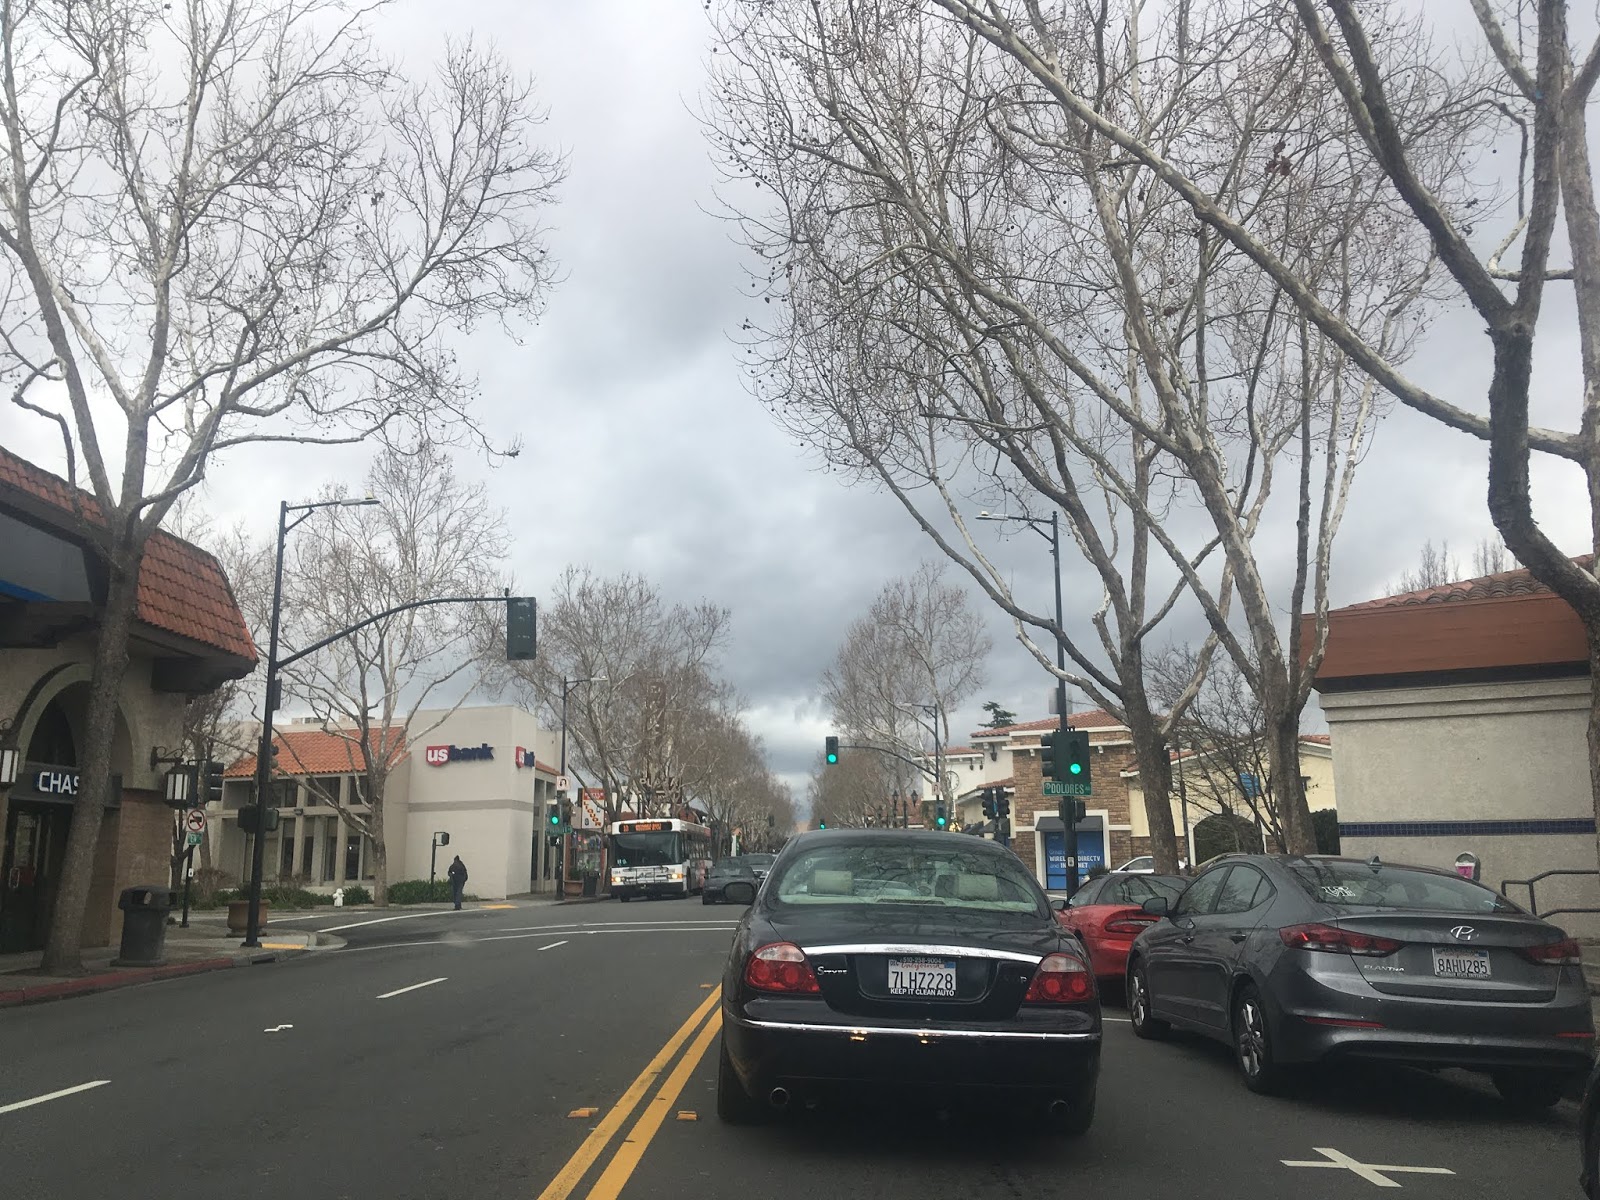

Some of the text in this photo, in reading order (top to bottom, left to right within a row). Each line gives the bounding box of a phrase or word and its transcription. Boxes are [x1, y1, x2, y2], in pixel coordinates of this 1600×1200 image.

[39, 771, 80, 795] CHAS
[1051, 783, 1085, 795] DOLORES
[1437, 958, 1488, 975] 8AHU285
[891, 970, 953, 991] 7LHZ228
